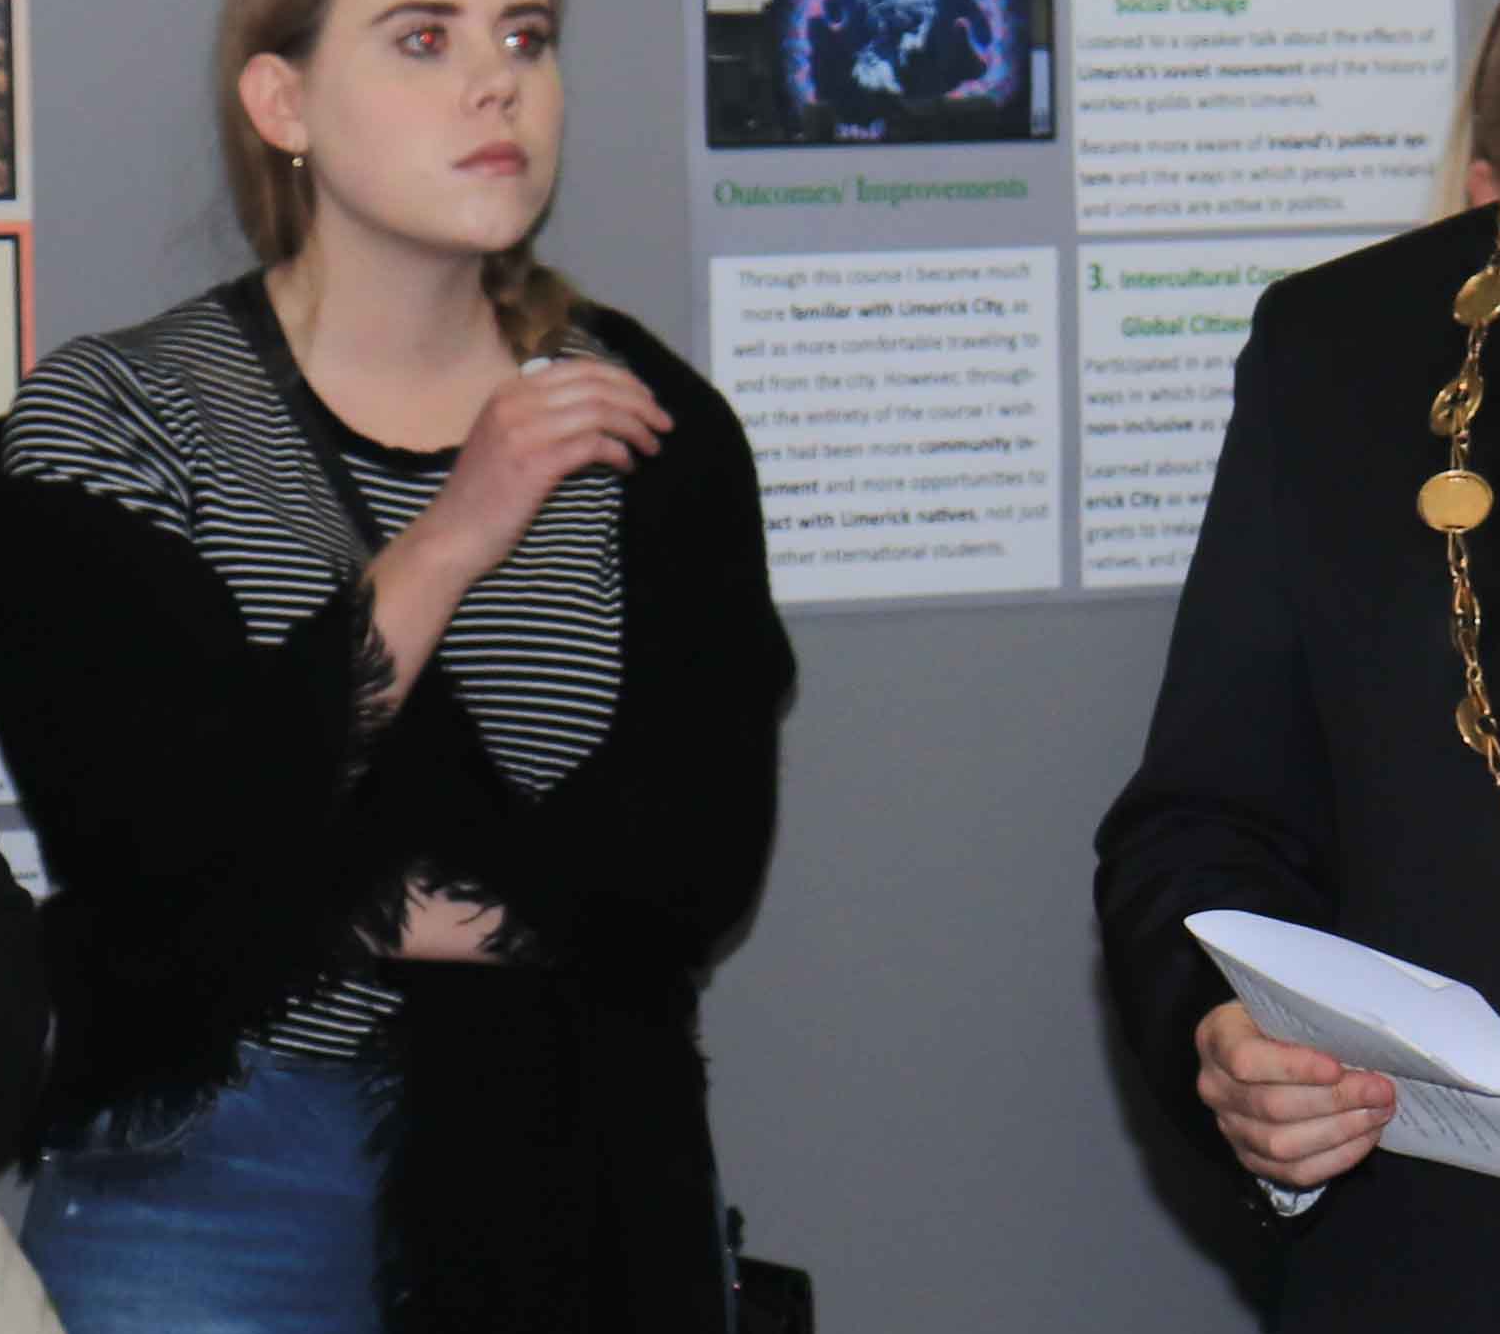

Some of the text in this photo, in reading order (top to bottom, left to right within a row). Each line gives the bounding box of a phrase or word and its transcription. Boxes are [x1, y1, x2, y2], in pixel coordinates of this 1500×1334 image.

[856, 174, 1029, 207] Improvements
[739, 263, 1030, 291] Through this course became much
[1120, 265, 1241, 290] Intercultural
[743, 307, 784, 321] more
[790, 303, 852, 321] familiar
[859, 301, 893, 318] with
[899, 299, 968, 317] Limerick
[1121, 316, 1184, 337] Global
[733, 339, 764, 358] well
[772, 344, 787, 356] as
[794, 341, 836, 355] more
[841, 334, 941, 354] comfortable
[1023, 333, 1038, 348] to
[734, 376, 763, 395] and
[769, 375, 808, 393] from
[815, 373, 841, 391] the
[826, 476, 856, 494] and
[863, 477, 904, 492] more
[911, 470, 1023, 495] opportunities
[1028, 469, 1045, 486] to
[799, 511, 835, 529] with
[841, 509, 910, 527] Limerick
[821, 543, 927, 561] international
